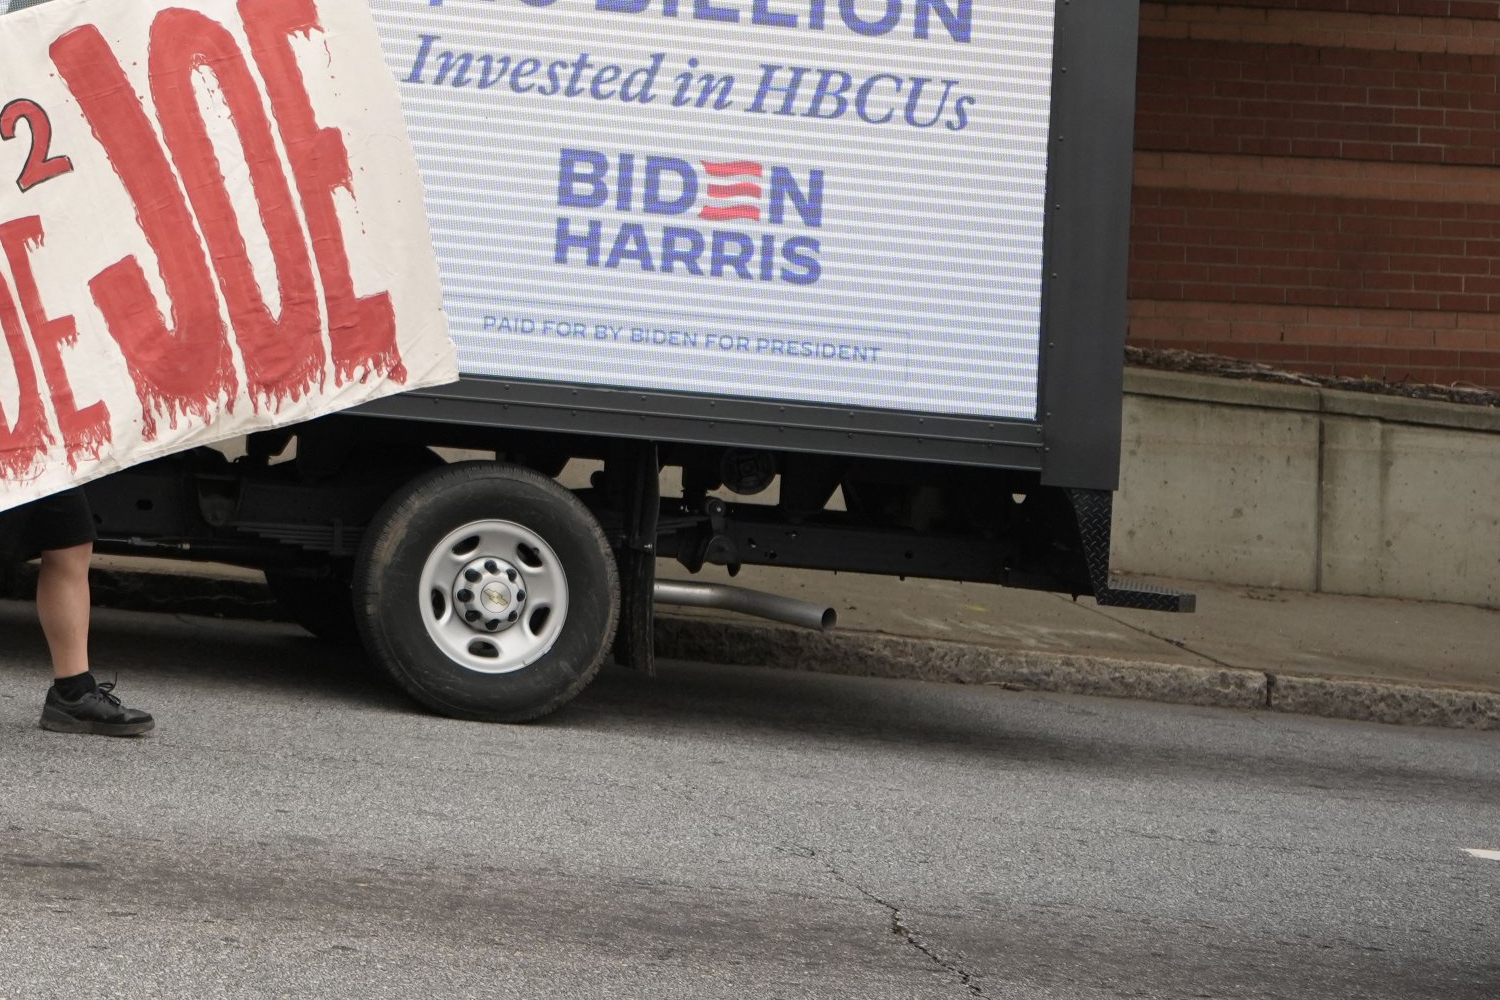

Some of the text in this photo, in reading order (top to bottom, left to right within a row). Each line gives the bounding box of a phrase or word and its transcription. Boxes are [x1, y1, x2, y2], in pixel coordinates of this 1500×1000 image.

[400, 33, 977, 132] Invested in HBCUs
[556, 147, 825, 229] BIDEN
[552, 216, 823, 286] HARRIS
[482, 314, 883, 364] PAID FOR BY BIDEN FOR PRESIDENT
